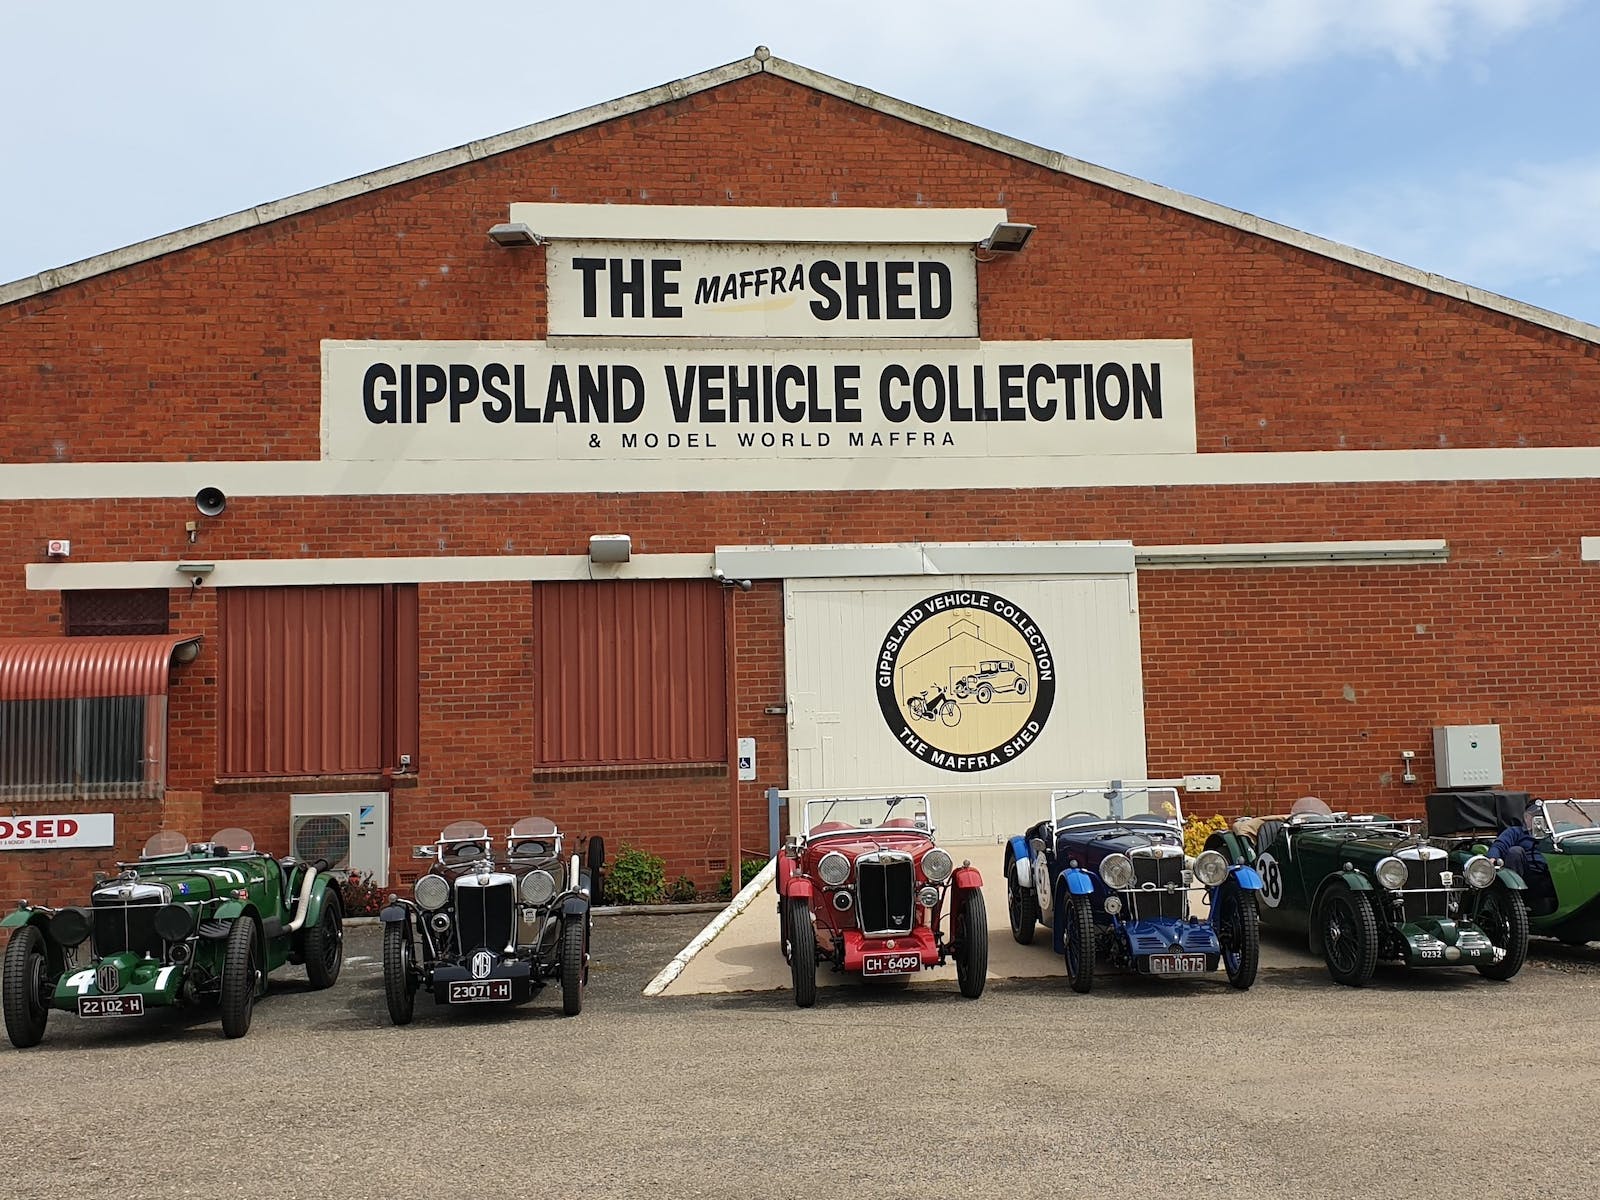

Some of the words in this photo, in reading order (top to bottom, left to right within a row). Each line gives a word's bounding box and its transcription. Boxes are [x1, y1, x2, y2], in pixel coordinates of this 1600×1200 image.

[572, 257, 683, 319] THE
[694, 264, 804, 305] MAFFRA
[808, 259, 952, 321] SHED
[363, 362, 646, 425] GIPPSLAND
[664, 364, 862, 424] VEHICLE
[879, 361, 1163, 423] COLLECTION
[589, 433, 601, 448] &
[622, 432, 717, 448] MODEL
[737, 432, 831, 448] WORLD
[849, 431, 955, 447] MAFFRA
[879, 608, 924, 687] GIPPSLAND
[925, 593, 990, 613] VEHICLE
[993, 600, 1052, 681] COLLECTION
[900, 726, 929, 756] THE
[930, 751, 1001, 770] MAFFRA
[1003, 720, 1040, 757] SHED
[1259, 858, 1280, 899] 38
[472, 952, 491, 978] MG
[1422, 950, 1442, 959] 0232
[1470, 949, 1480, 957] H3
[66, 968, 97, 995] 4
[98, 965, 119, 994] MG
[154, 965, 176, 991] 1
